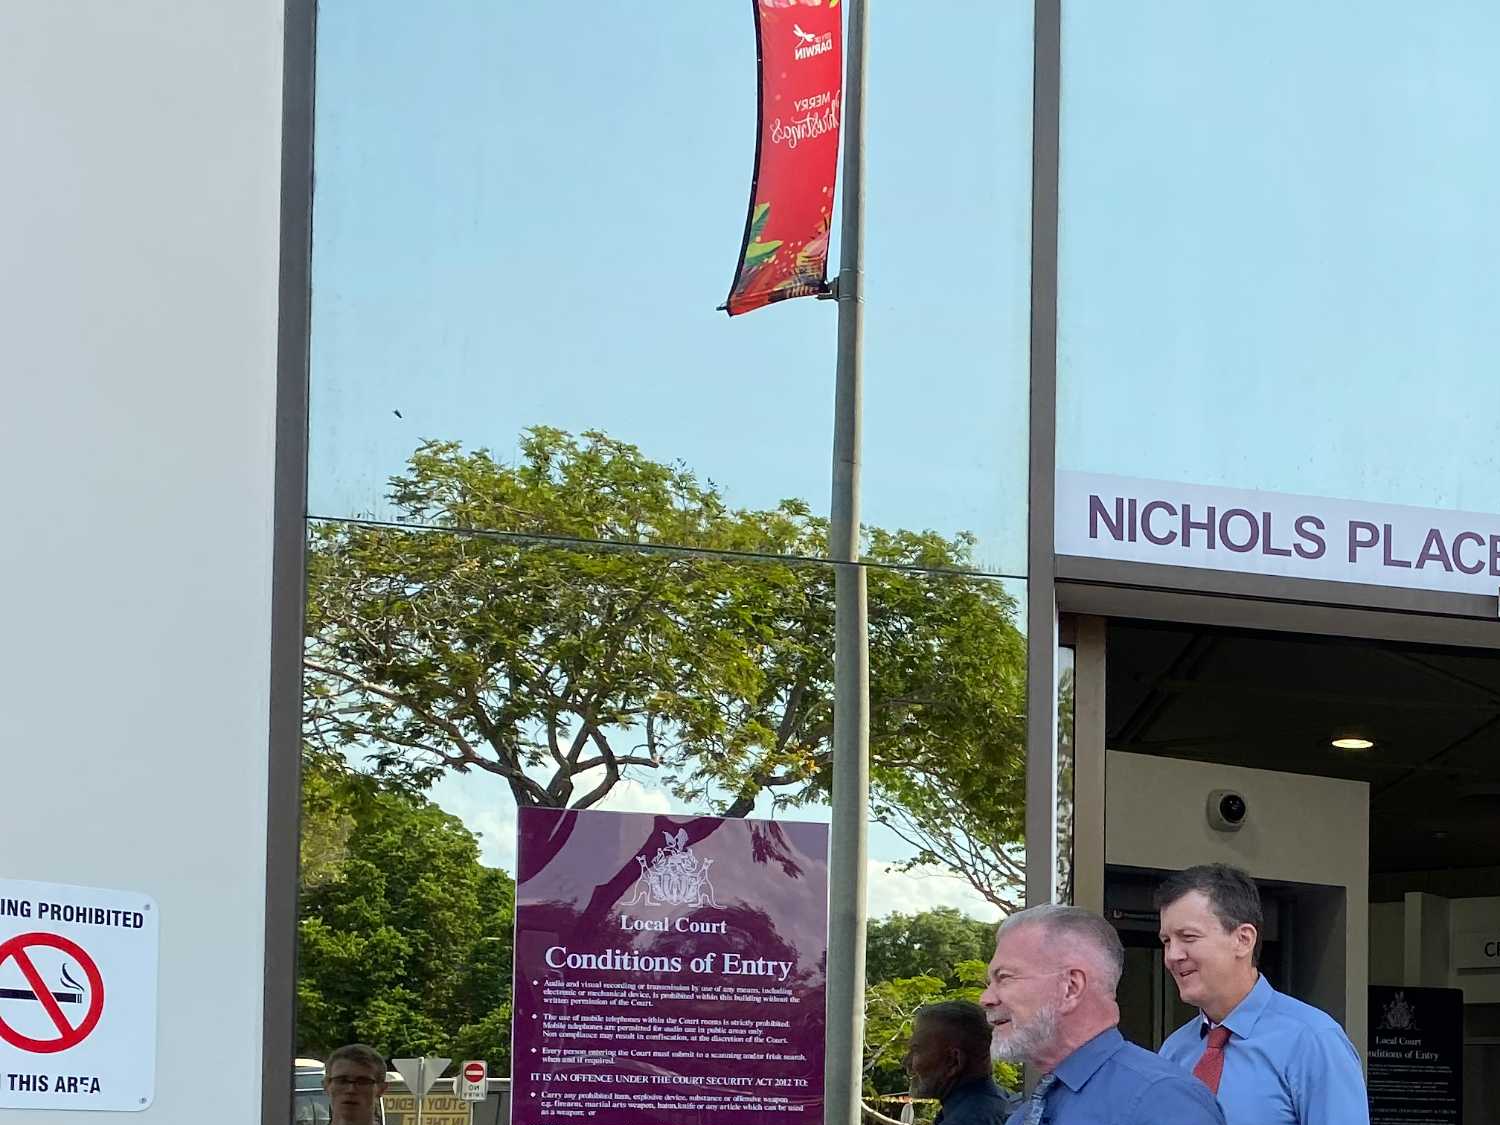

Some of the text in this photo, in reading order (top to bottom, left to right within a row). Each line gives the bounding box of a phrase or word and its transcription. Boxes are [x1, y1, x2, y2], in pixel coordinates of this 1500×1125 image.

[1088, 495, 1326, 560] NICHOLS
[38, 903, 143, 928] PROHIBITED
[620, 916, 727, 935] Local Court
[545, 946, 793, 981] Conditions of Entry
[543, 1030, 558, 1038] Non
[559, 1032, 598, 1040] compliance
[616, 1032, 634, 1040] result
[1376, 1036, 1421, 1046] Local Court
[543, 1047, 561, 1055] Every
[588, 1049, 616, 1057] entering
[1405, 1051, 1413, 1060] of
[1415, 1051, 1439, 1062] Entry
[8, 1074, 48, 1092] THIS
[543, 1073, 551, 1081] IS
[555, 1073, 568, 1081] AN
[570, 1074, 613, 1082] OFFENCE
[616, 1075, 648, 1083] UNDER
[651, 1076, 671, 1084] THE
[673, 1076, 704, 1084] COURT
[706, 1077, 753, 1086] SECURITY
[755, 1078, 773, 1086] ACT
[775, 1078, 792, 1086] 2012
[794, 1079, 808, 1087] TO:
